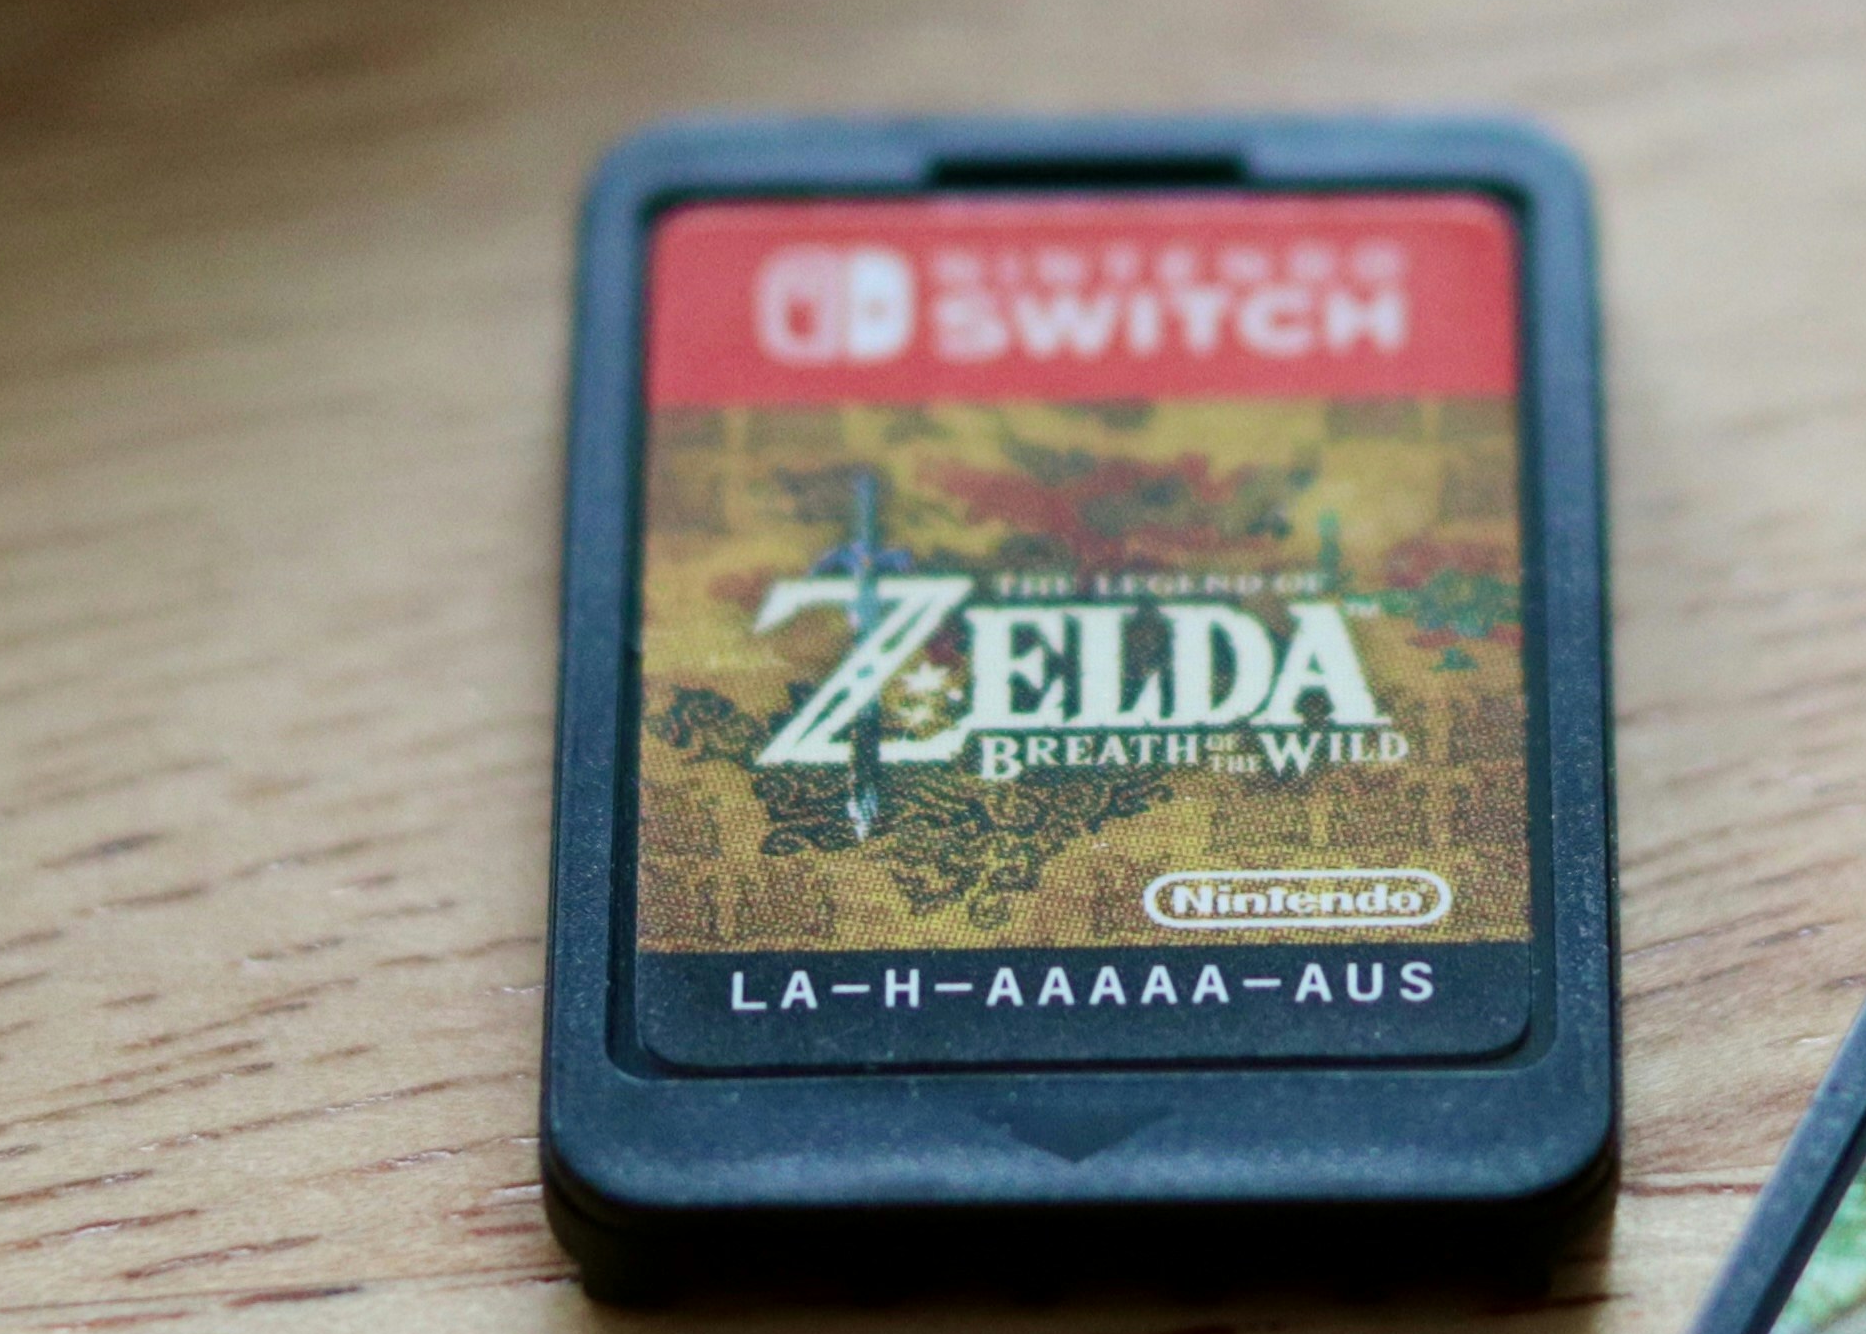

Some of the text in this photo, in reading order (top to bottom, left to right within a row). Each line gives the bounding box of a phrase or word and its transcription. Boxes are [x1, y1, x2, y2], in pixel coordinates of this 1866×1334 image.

[936, 287, 1405, 360] SWITCH
[754, 573, 1391, 765] ZELDA
[981, 732, 1198, 781] BREATH
[1260, 730, 1410, 779] WILD
[1173, 883, 1425, 915] Nintendo
[732, 960, 1435, 1011] LA-H-AAAAA-AUS
